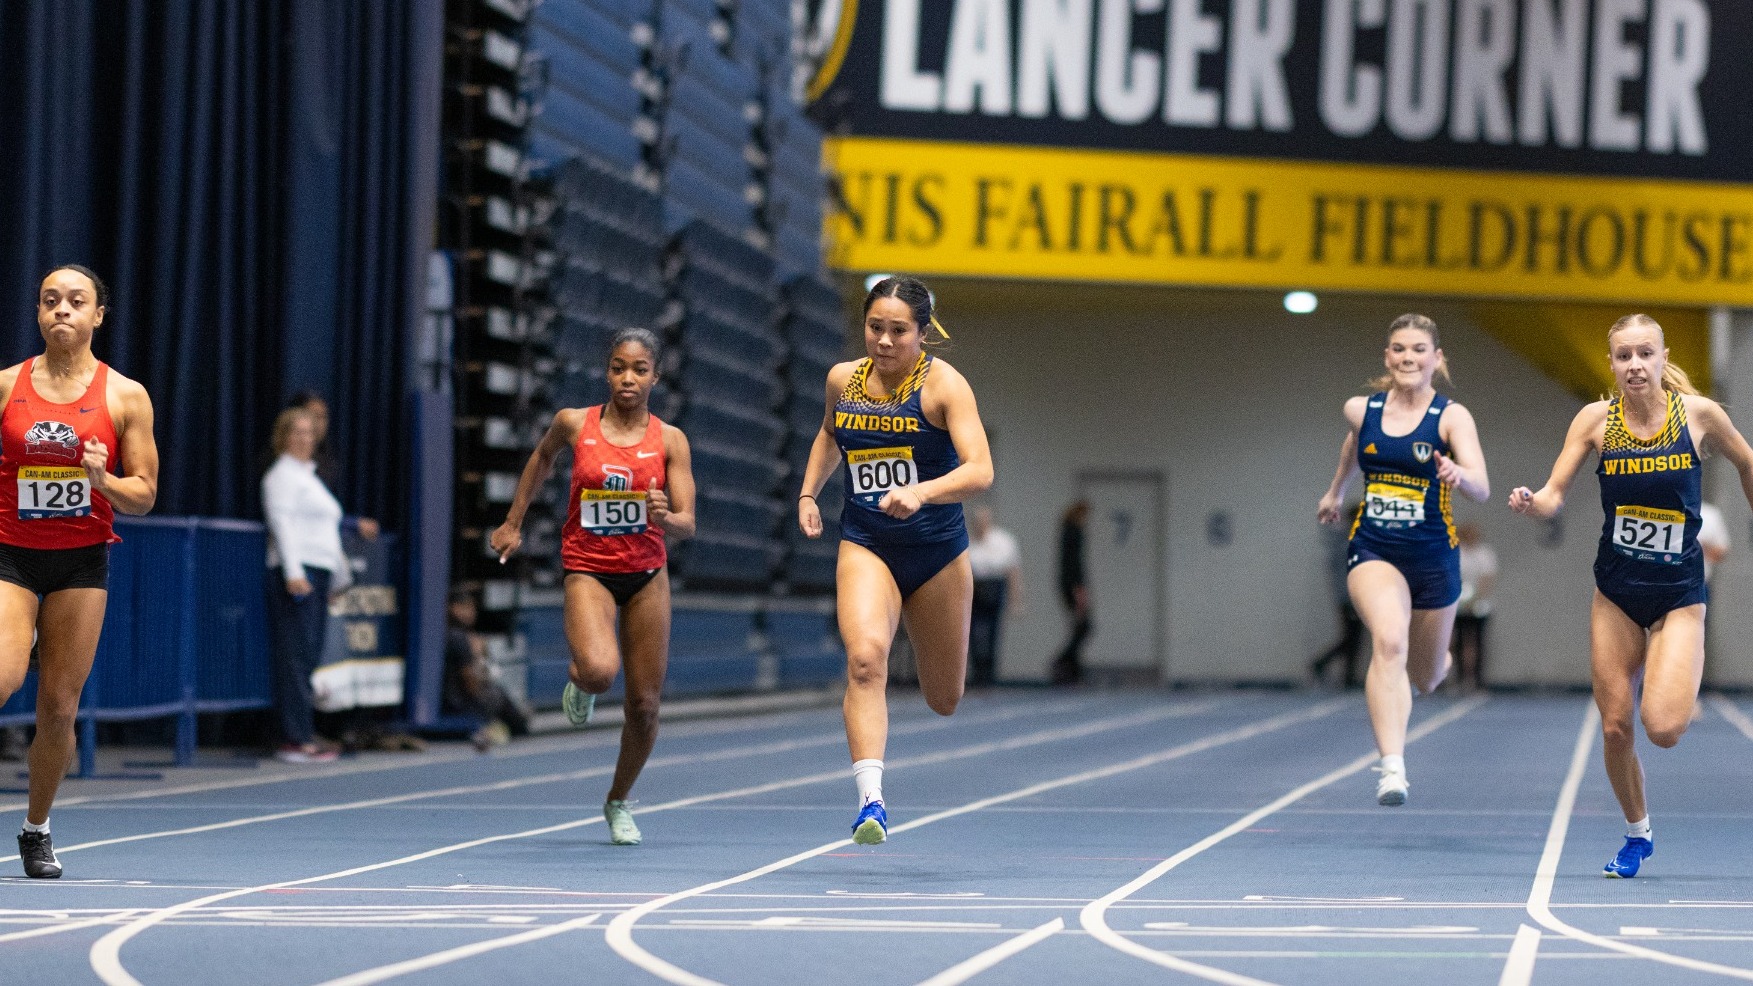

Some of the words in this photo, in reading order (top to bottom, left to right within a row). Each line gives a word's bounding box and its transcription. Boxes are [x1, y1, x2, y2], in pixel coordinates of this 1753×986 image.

[880, 0, 1294, 131] LANCER
[1318, 0, 1709, 155] CORNER
[973, 177, 1286, 263] FAIRALL
[1309, 191, 1753, 284] FIELDHOUSE
[835, 411, 920, 433] WINDSOR
[25, 469, 51, 479] CAN-AM
[53, 470, 80, 479] CLASSIC
[857, 460, 911, 490] 600
[1604, 453, 1692, 475] WINDSOR
[28, 481, 84, 508] 128
[590, 501, 640, 524] 150
[1623, 509, 1648, 518] CAN-AM
[1650, 511, 1676, 522] CLASSIC
[1620, 518, 1672, 550] 521
